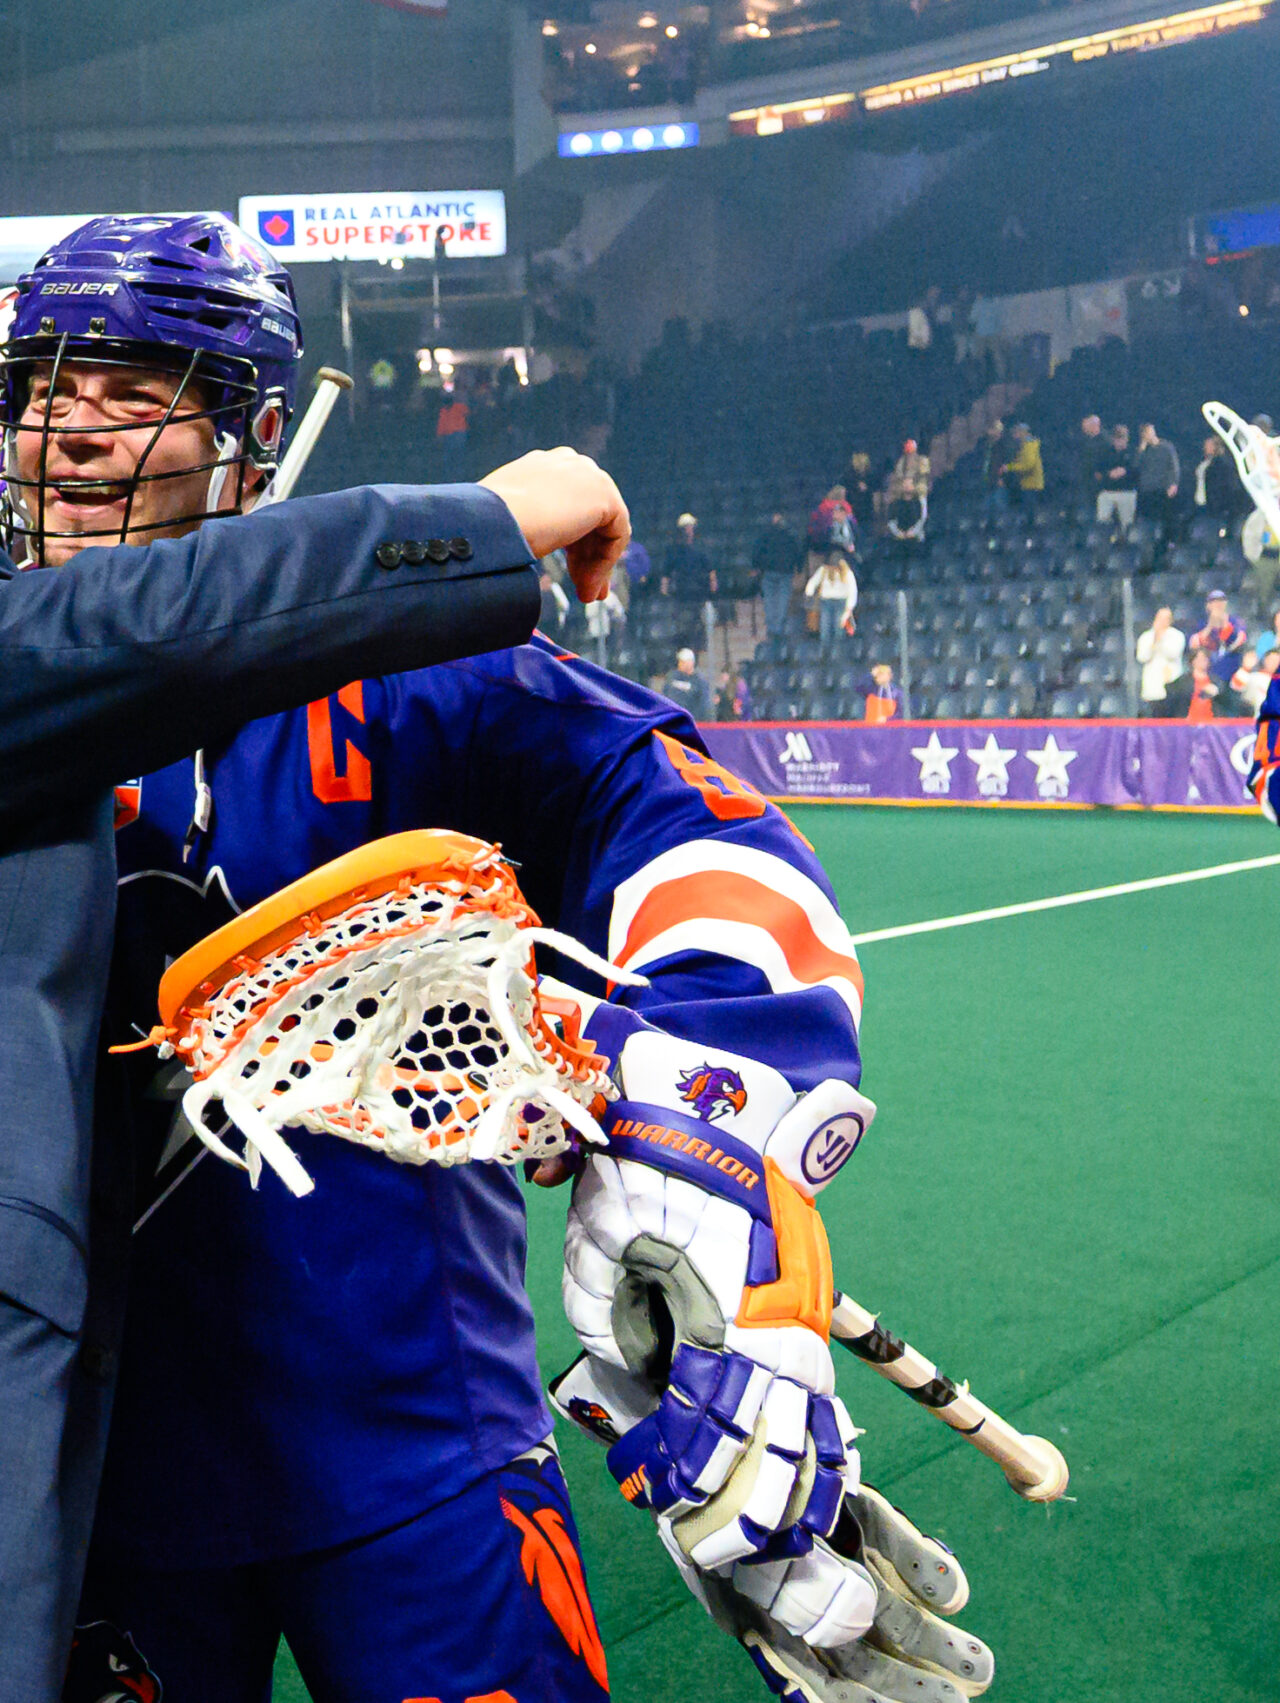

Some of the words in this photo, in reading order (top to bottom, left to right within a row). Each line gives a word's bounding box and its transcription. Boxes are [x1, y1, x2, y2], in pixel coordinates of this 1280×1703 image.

[305, 206, 357, 221] REAL
[370, 202, 475, 220] ATLANTIC
[611, 1119, 760, 1191] WARRIOR
